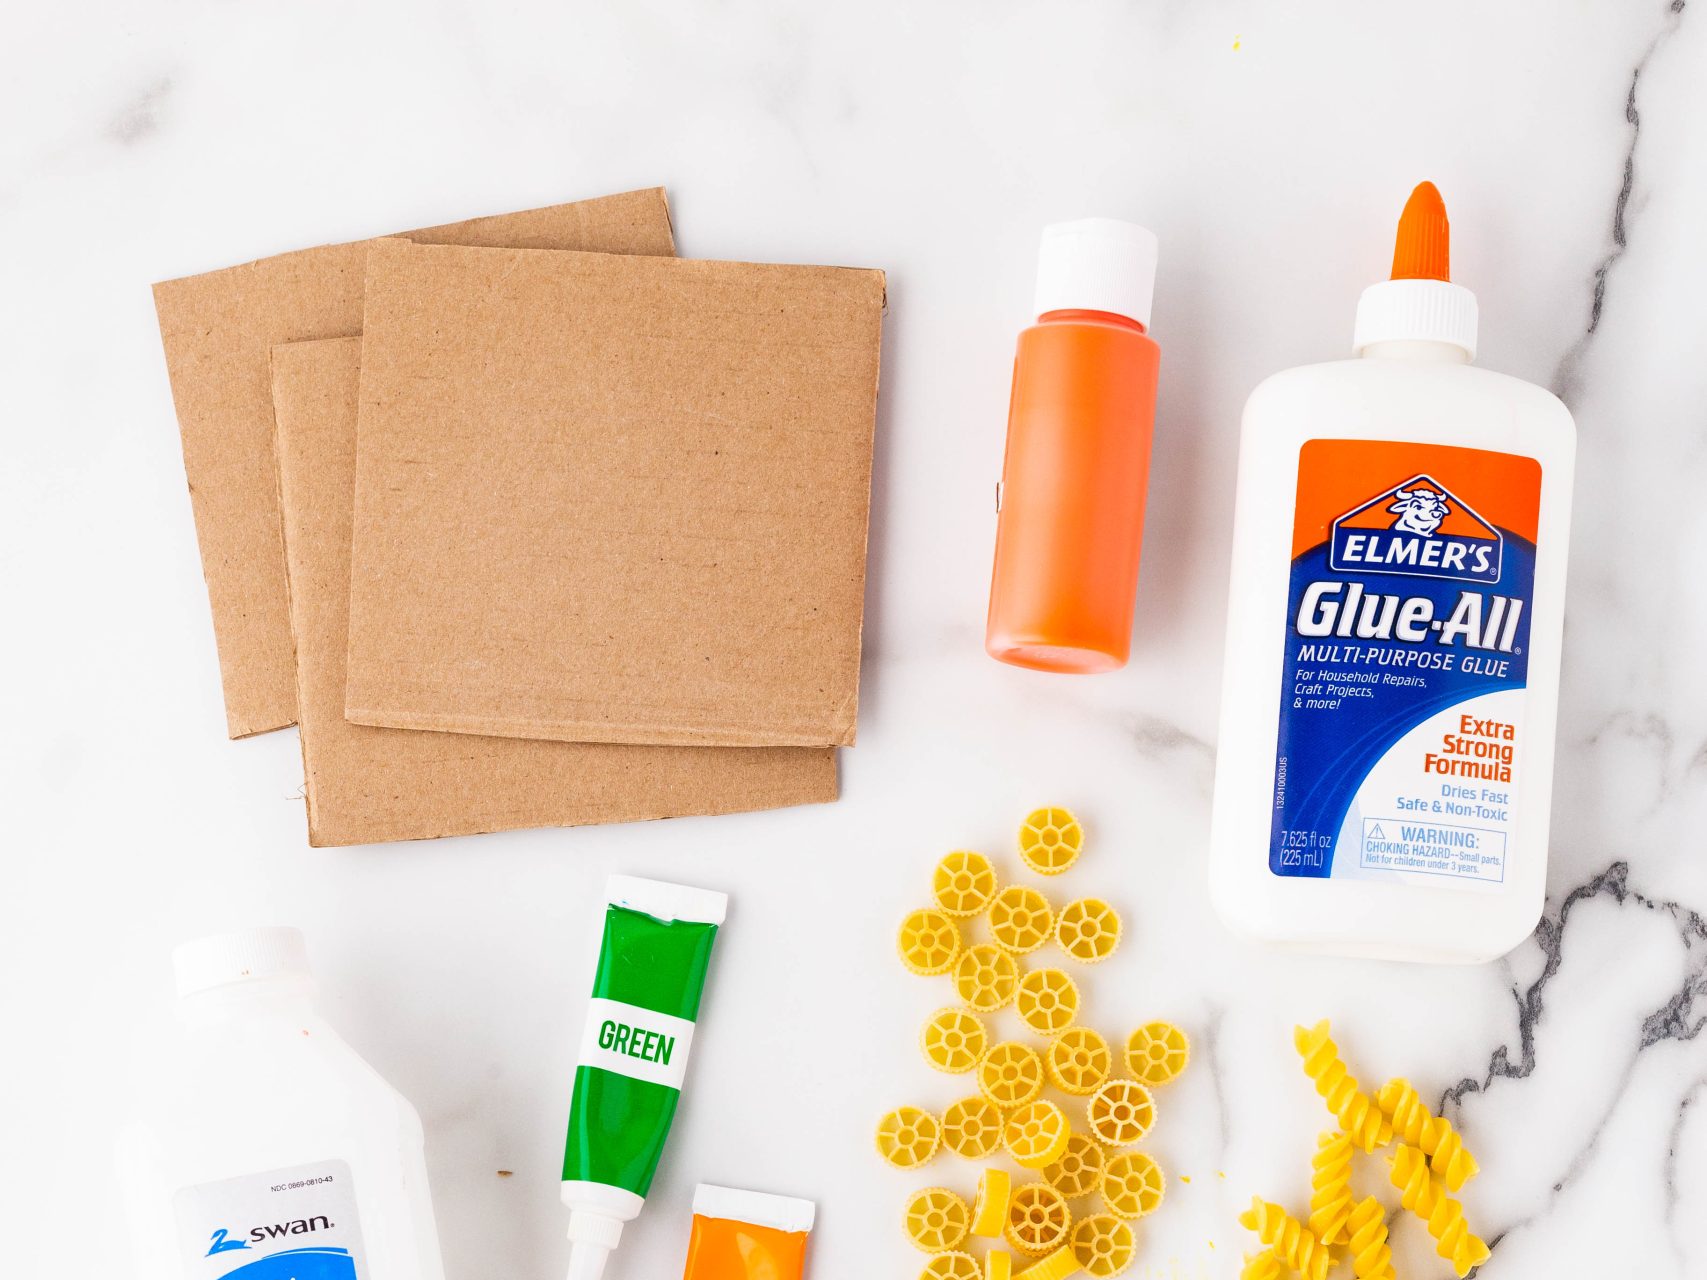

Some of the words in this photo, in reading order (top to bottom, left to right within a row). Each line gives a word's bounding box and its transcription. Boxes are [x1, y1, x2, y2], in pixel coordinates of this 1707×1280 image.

[1342, 534, 1492, 572] ELMER'S
[1297, 581, 1524, 652] Glue-All
[1297, 645, 1455, 670] MULTI-PURPOSE
[1461, 656, 1510, 678] GLUE
[1294, 683, 1324, 694] Craft
[1326, 684, 1374, 698] Projects,
[1295, 669, 1315, 681] For
[1318, 670, 1380, 684] Household
[1382, 673, 1428, 688] Repairs,
[1293, 698, 1302, 708] &
[1306, 698, 1341, 710] more!
[1460, 714, 1515, 740] Extra
[1442, 734, 1514, 764] Strong
[1424, 753, 1512, 782] Formula
[1441, 784, 1476, 800] Dries
[1481, 789, 1508, 804] Fast
[1397, 797, 1428, 812] Safe
[1432, 800, 1442, 812] &
[1445, 801, 1508, 822] Non-Toxic
[1281, 831, 1308, 847] 7.625
[1310, 831, 1316, 847] fl
[1319, 836, 1332, 848] oz
[1401, 826, 1480, 850] WARNING:
[1280, 849, 1302, 868] (225
[1303, 849, 1324, 868] mL)
[1365, 853, 1379, 864] Not
[1381, 854, 1392, 864] for
[1394, 855, 1426, 868] children
[1427, 859, 1450, 870] under
[1451, 861, 1456, 871] 3
[1457, 863, 1480, 874] years.
[1366, 840, 1410, 854] CHOKING
[1481, 855, 1502, 866] parts.
[598, 1019, 675, 1066] GREEN
[271, 1184, 287, 1192] NDC
